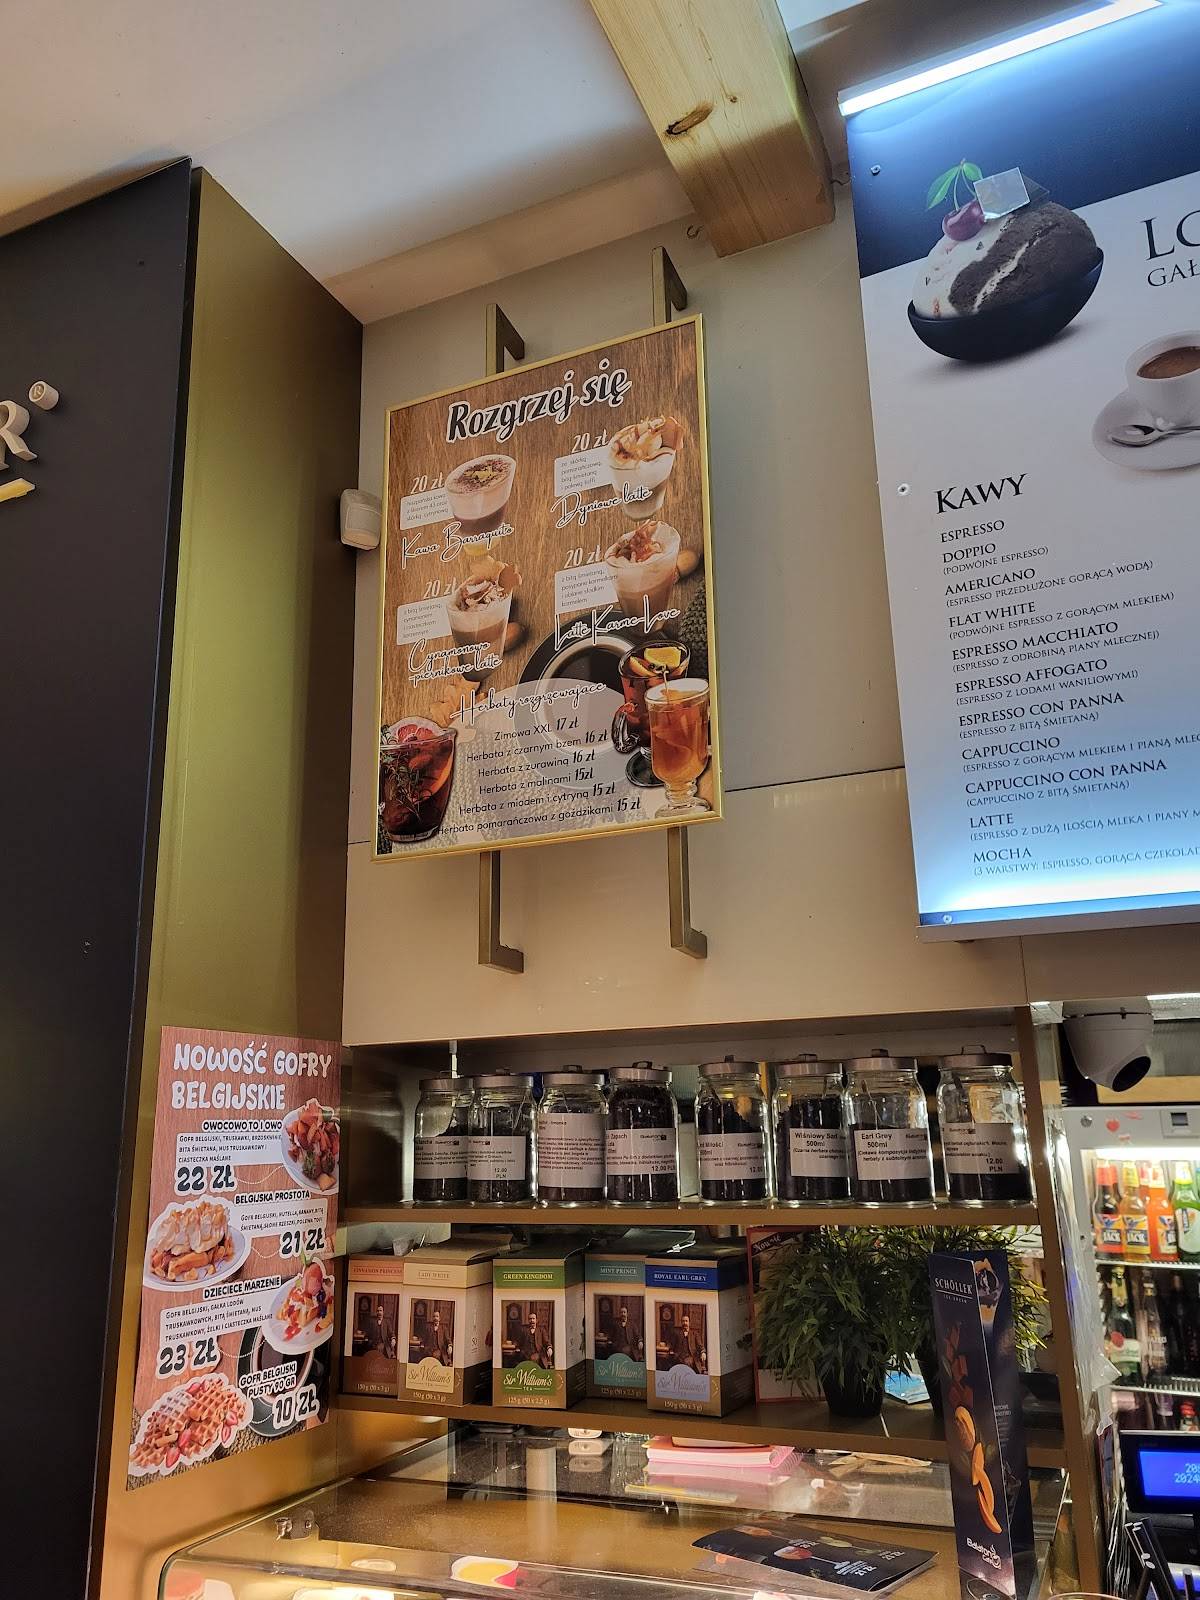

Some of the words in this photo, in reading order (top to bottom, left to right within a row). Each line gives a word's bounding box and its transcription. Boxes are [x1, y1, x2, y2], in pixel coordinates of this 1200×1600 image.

[446, 370, 579, 443] Rozgrzej
[580, 358, 632, 407] się
[572, 433, 590, 453] 20
[594, 429, 609, 447] zł
[411, 476, 427, 494] 20
[432, 473, 445, 488] zł
[934, 474, 1028, 514] KAWY
[550, 491, 622, 528] Dyniowe
[623, 481, 653, 504] latte
[402, 532, 440, 569] Kawa
[440, 521, 514, 562] Barraquito
[941, 520, 1005, 543] ESPRESSO
[564, 548, 583, 568] 20
[587, 545, 602, 563] zł
[943, 543, 996, 563] DOPPIO
[943, 558, 998, 576] (PODWÓJNE
[1001, 546, 1049, 563] ESPRESSO)
[424, 580, 440, 599] 20
[444, 577, 458, 595] zł
[945, 568, 1036, 595] AMERICANO
[946, 592, 992, 608] (ESPRESSO
[995, 577, 1065, 598] PRZEDŁUŻONE
[1069, 567, 1114, 584] GORĄCĄ
[1115, 560, 1154, 574] WODĄ)
[949, 612, 982, 627] FLAT
[985, 602, 1036, 621] WHITE
[950, 624, 1005, 640] (PODWÓJNE
[1009, 614, 1053, 630] ESPRESSO
[1066, 603, 1120, 620] GORĄCYM
[1123, 591, 1175, 609] MLEKIEM)
[555, 614, 591, 651] Latte
[952, 640, 1018, 660] ESPRESSO
[1022, 621, 1118, 648] MACCHIATO
[475, 647, 503, 671] latte
[953, 658, 999, 673] (ESPRESSO
[1011, 647, 1066, 663] ODROBINĄ
[1069, 642, 1100, 654] PIANY
[1104, 631, 1160, 647] MLECZNEJ)
[956, 673, 1021, 693] ESPRESSO
[1025, 659, 1108, 683] AFFOGATO
[957, 691, 1003, 706] (ESPRESSO
[1016, 683, 1056, 696] LODAMI
[1059, 669, 1139, 690] WANILIOWYMI)
[450, 687, 518, 726] Herbaty
[959, 707, 1025, 727] ESPRESSO
[1030, 701, 1064, 716] CON
[1070, 692, 1125, 711] PANNA
[494, 729, 531, 741] Zimowa
[533, 724, 553, 735] XXL
[556, 719, 566, 731] 17
[567, 717, 579, 729] zł
[959, 725, 1007, 740] (ESPRESSO
[1020, 720, 1041, 730] BITĄ
[1044, 711, 1100, 727] ŚMIETANĄ)
[466, 751, 504, 763] Herbata
[514, 743, 553, 755] czarnym
[556, 737, 581, 748] bzem
[585, 731, 595, 743] 16
[596, 729, 608, 741] zł
[962, 736, 1060, 760] CAPPUCCINO
[963, 758, 1011, 773] (ESPRESSO
[1023, 750, 1075, 764] GORĄCYM
[1079, 744, 1126, 757] MLEKIEM
[1138, 738, 1171, 750] PIANĄ
[479, 765, 515, 777] Herbata
[573, 751, 583, 763] 16
[585, 749, 595, 761] zł
[965, 772, 1064, 794] CAPPUCCINO
[1069, 766, 1105, 781] CON
[1111, 759, 1168, 776] PANNA
[479, 783, 517, 795] Herbata
[527, 773, 571, 787] malinami
[967, 790, 1034, 807] (CAPPUCCINO
[1048, 787, 1070, 798] BITĄ
[1072, 779, 1130, 795] ŚMIETANĄ)
[459, 804, 497, 816] Herbata
[507, 796, 544, 807] miodem
[553, 790, 589, 803] cytryną
[592, 785, 603, 797] 15
[604, 782, 615, 795] zł
[437, 823, 474, 835] Herbata
[477, 812, 548, 830] pomarańczowa
[558, 805, 613, 821] goździkami
[617, 799, 628, 811] 15
[629, 798, 641, 810] zł
[970, 813, 1015, 828] LATTE
[970, 828, 1018, 841] (ESPRESSO
[1032, 823, 1060, 835] DUŻĄ
[1063, 820, 1104, 832] ILOŚCIĄ
[1107, 814, 1143, 826] MLEKA
[1155, 810, 1188, 821] PIANY
[973, 847, 1032, 863] MOCHA
[174, 1041, 268, 1075] NOWOŚĆ
[274, 1050, 332, 1078] GOFRY
[172, 1081, 286, 1110] BELGIJSKIE
[203, 1121, 248, 1130] OWOCOWO
[248, 1121, 258, 1130] TO
[264, 1121, 282, 1130] OWO
[794, 1132, 825, 1140] Wiśniowy
[875, 1132, 892, 1141] Grey
[177, 1166, 204, 1191] 22
[213, 1165, 234, 1188] ZŁ
[236, 1193, 273, 1204] BELGIJSKA
[275, 1190, 309, 1200] PROSTOTA
[282, 1231, 300, 1254] 21
[306, 1228, 324, 1250] ZŁ
[245, 1277, 280, 1291] MARZENIE
[600, 1267, 615, 1275] MINT
[690, 1274, 707, 1282] GREY
[166, 1311, 181, 1319] GOFR
[159, 1344, 186, 1374] 23
[193, 1337, 217, 1366] ZŁ
[241, 1374, 260, 1386] GOFR
[263, 1363, 296, 1380] BELGIJSKI
[249, 1384, 272, 1397] PUSTY
[275, 1380, 283, 1391] 90
[286, 1377, 294, 1386] GR
[407, 1369, 419, 1380] Sir
[419, 1365, 451, 1384] William's
[503, 1373, 516, 1386] Sir
[516, 1368, 553, 1386] William's
[276, 1397, 292, 1423] 10
[299, 1389, 316, 1416] ZŁ
